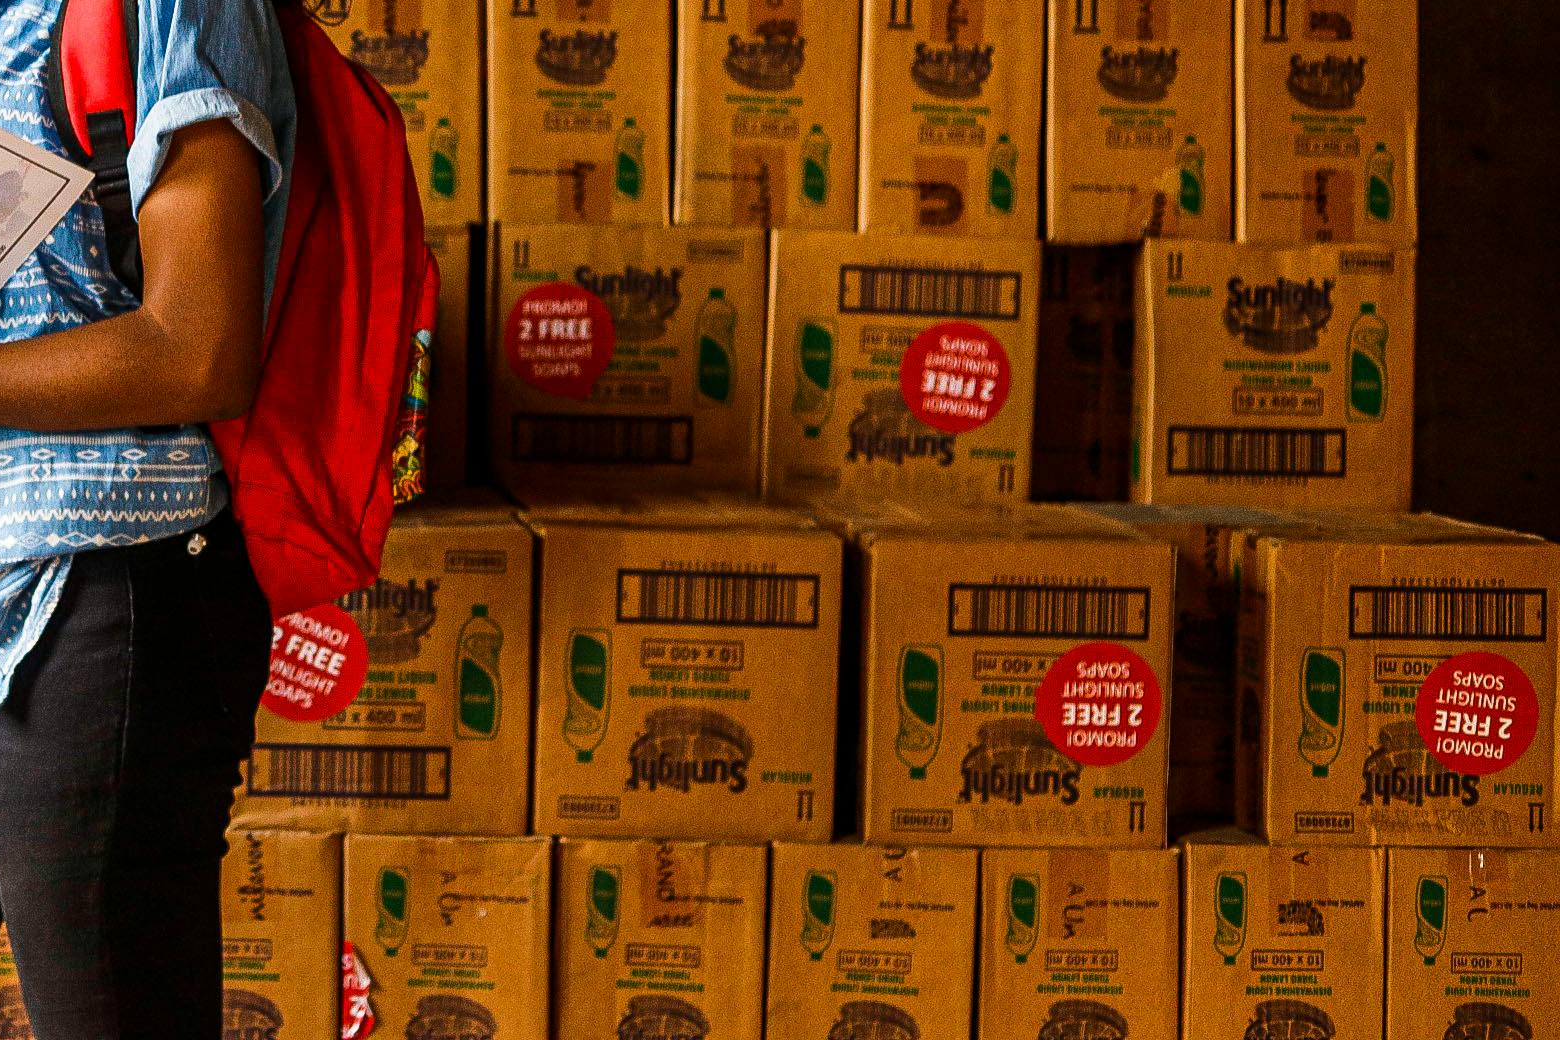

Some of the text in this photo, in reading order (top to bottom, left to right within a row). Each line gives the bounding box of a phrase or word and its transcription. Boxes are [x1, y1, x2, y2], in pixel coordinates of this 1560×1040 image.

[574, 264, 682, 305] Sunlight
[1227, 276, 1336, 316] Sunlight
[519, 319, 591, 340] 2 FREE
[920, 370, 996, 401] 2 FREE
[846, 430, 956, 466] Sunlight
[338, 578, 438, 620] unlight
[271, 625, 346, 677] 2 FREE
[1076, 661, 1130, 679] SOAPS
[1453, 670, 1504, 691] SOAPS
[1063, 680, 1144, 699] SUNLIGHT
[1436, 689, 1516, 712] SUNLIGHT
[1061, 702, 1142, 726] 2 FREE
[1434, 709, 1513, 739] 2 FREE
[1067, 730, 1136, 747] PROMO!
[1437, 737, 1504, 760] PROMO!
[626, 755, 748, 792] Sunlight
[958, 762, 1080, 805] Sunlight
[1360, 764, 1480, 807] Sunlight
[1273, 954, 1291, 966] 400
[1307, 954, 1320, 966] 10
[1454, 957, 1468, 968] ml
[1471, 958, 1492, 969] 400
[1506, 958, 1519, 969] 10
